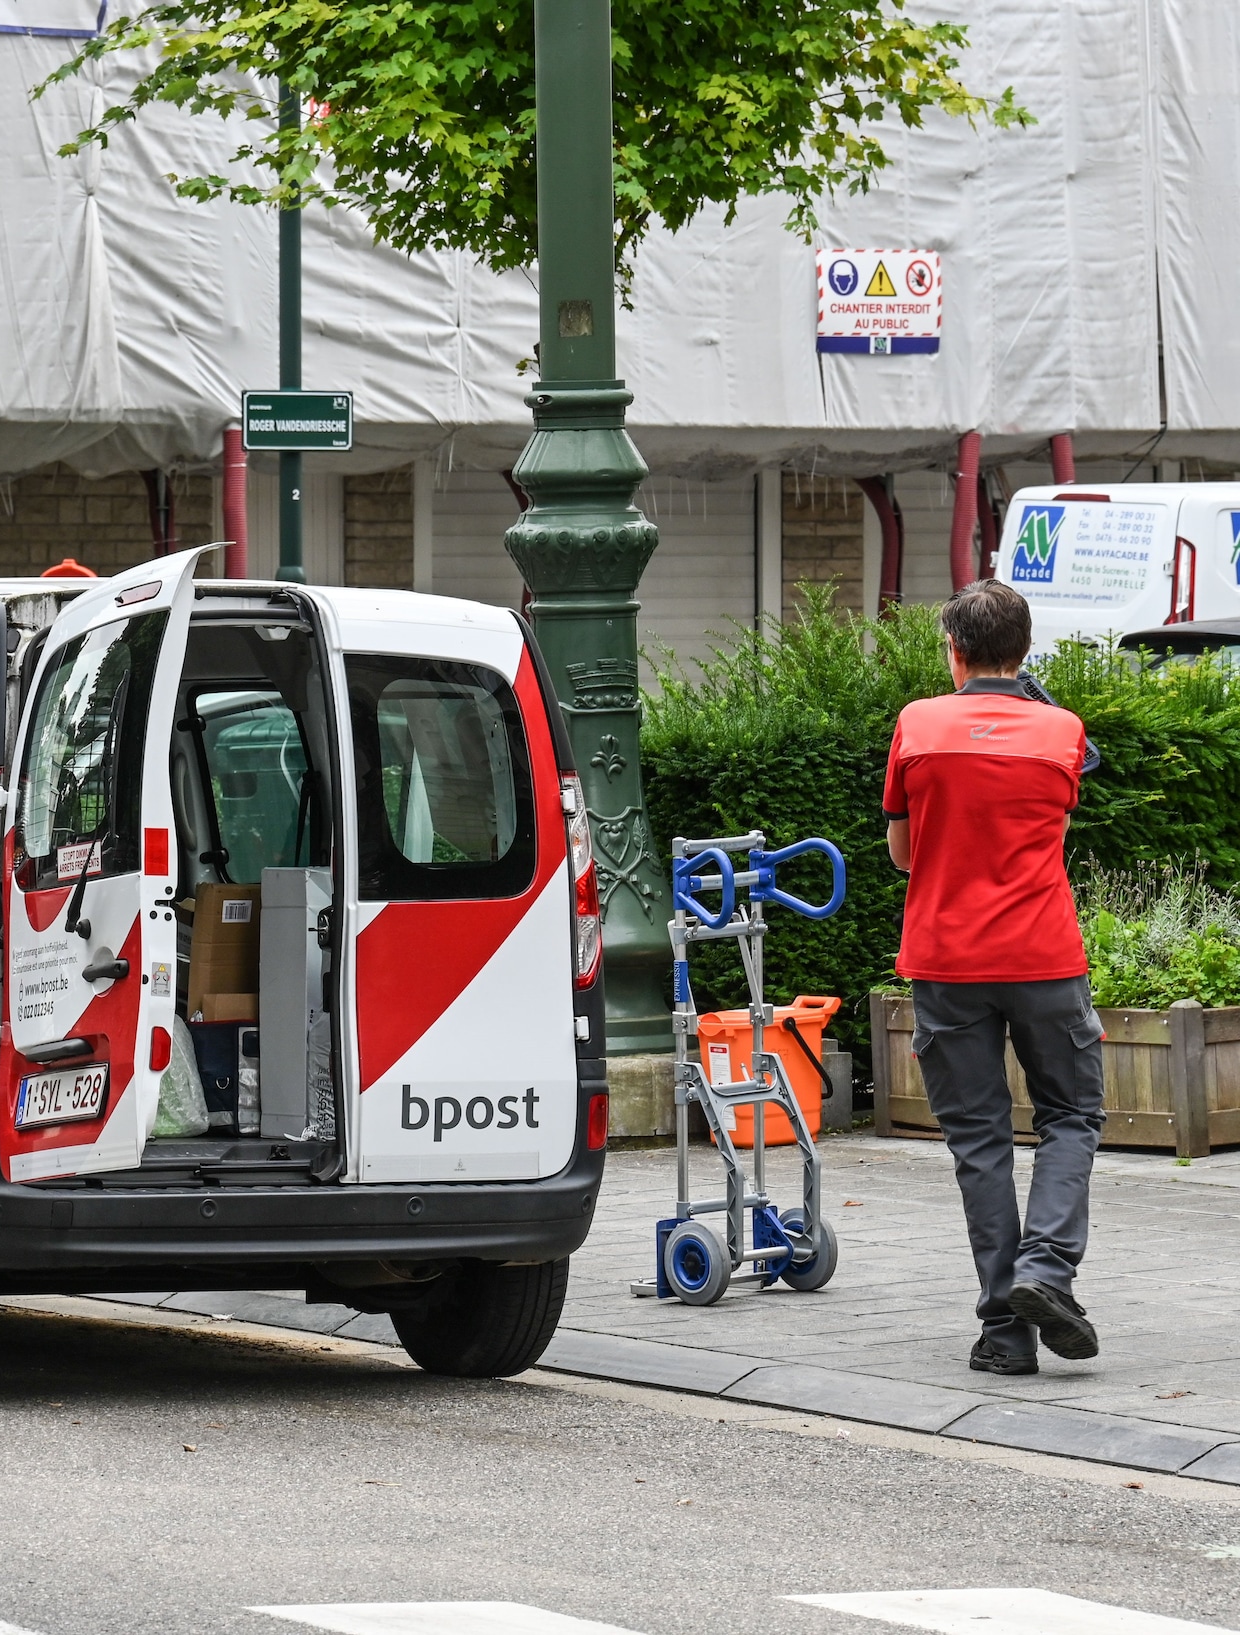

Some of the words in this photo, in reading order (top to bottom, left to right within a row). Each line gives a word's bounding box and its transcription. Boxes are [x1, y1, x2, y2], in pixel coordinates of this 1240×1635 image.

[830, 303, 883, 314] CHANTIER
[885, 304, 931, 314] INTERDIT
[854, 319, 870, 329] AU
[872, 319, 910, 329] PUBLIC
[249, 418, 276, 432] ROGER
[276, 419, 347, 433] VANDENDRIESSCHE
[292, 488, 300, 501] 2
[1135, 512, 1145, 520] 00
[1132, 524, 1142, 532] 00
[1011, 511, 1067, 566] AV
[1074, 549, 1149, 561] WWW.AVFACADE.BE
[1014, 565, 1051, 581] façade
[1072, 563, 1083, 572] Rue
[1084, 563, 1093, 573] de
[1102, 565, 1130, 576] Sucrerie
[1070, 576, 1091, 585] 4450
[1102, 579, 1145, 590] JUPRELLE
[24, 973, 69, 998] www.bpost.be
[673, 962, 681, 1002] EXPRESSO
[23, 1004, 34, 1020] 022
[33, 1001, 54, 1018] 012345
[401, 1084, 540, 1142] bpost
